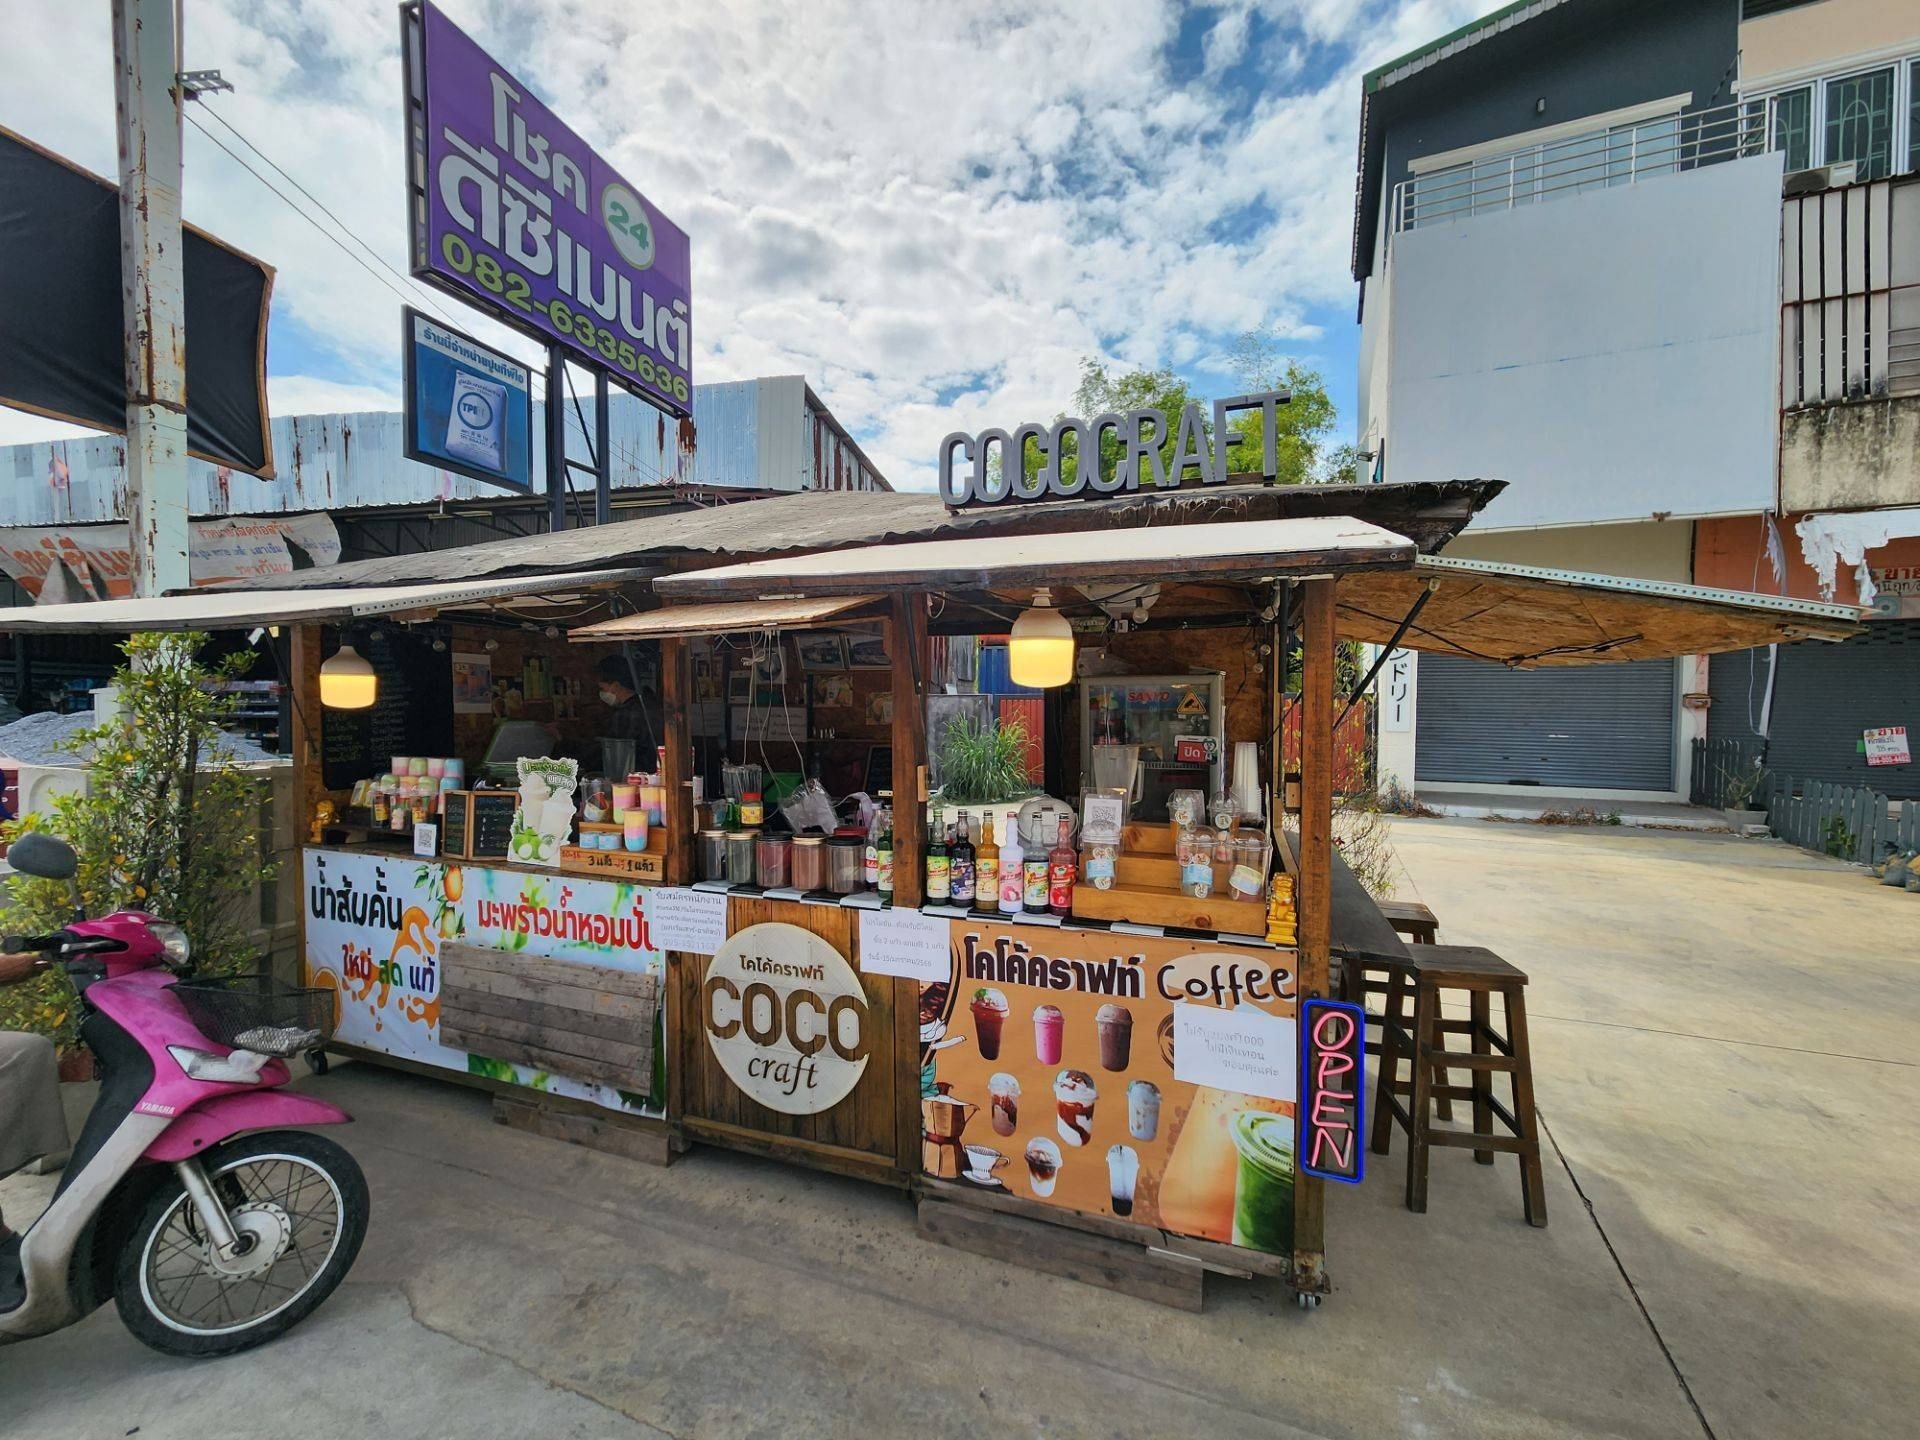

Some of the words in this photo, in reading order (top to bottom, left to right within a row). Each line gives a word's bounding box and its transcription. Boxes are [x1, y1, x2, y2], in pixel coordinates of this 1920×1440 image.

[489, 71, 588, 215] โชค
[438, 126, 688, 372] ดีซีเมนต์
[608, 201, 650, 252] 24
[442, 233, 689, 402] 082-6335636
[939, 390, 1292, 506] COCOCRAFT
[311, 855, 403, 931] น้ำส้มคั้น
[341, 943, 372, 980] ใหม่
[378, 959, 404, 987] สด
[409, 956, 436, 993] แท้
[739, 954, 825, 981] โคโค้คราฟท์
[963, 932, 1142, 998] โคโค้คราฟท์
[1157, 964, 1297, 1008] Coffee
[141, 1101, 176, 1115] YAMAHA
[747, 1055, 818, 1096] craft
[1311, 1010, 1356, 1170] OPEN
